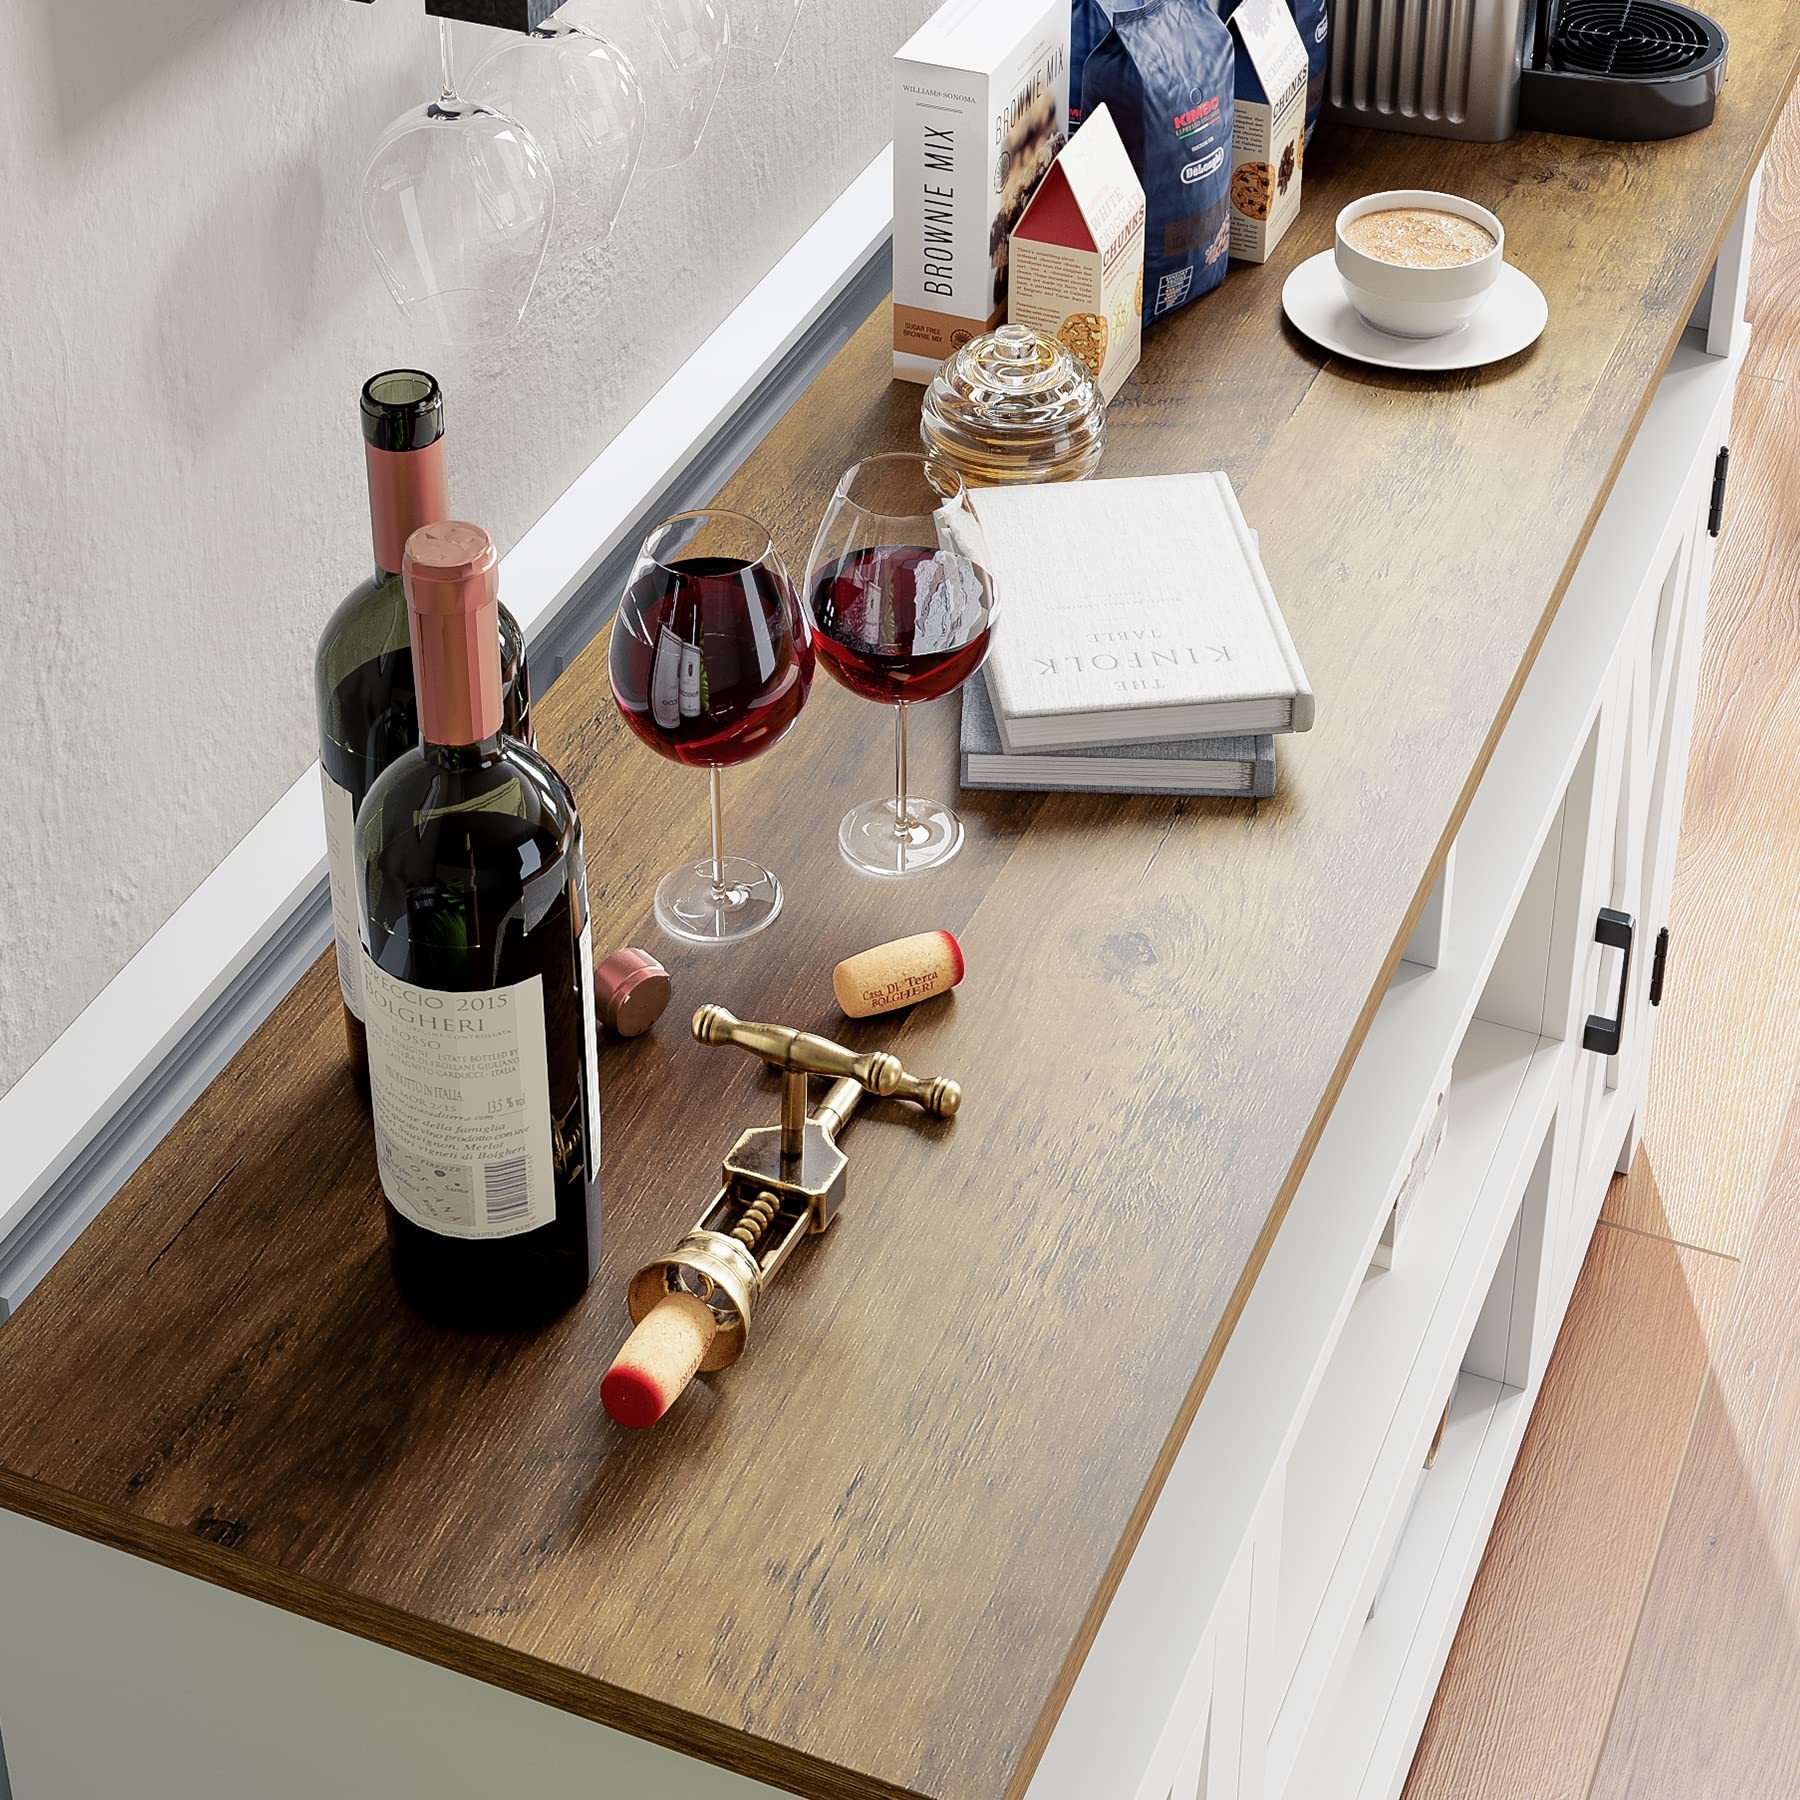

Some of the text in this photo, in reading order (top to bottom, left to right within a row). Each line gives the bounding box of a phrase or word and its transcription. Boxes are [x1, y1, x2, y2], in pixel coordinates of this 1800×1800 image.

[996, 68, 1042, 145] BROWNIE
[1046, 43, 1064, 87] MIX
[1273, 64, 1308, 118] CHUNKS
[1173, 96, 1220, 129] KIMBO
[924, 125, 954, 297] BROWNIE MIX
[1103, 204, 1144, 268] CHUNKS
[903, 329, 943, 343] BROWNIE MIX
[904, 321, 941, 334] SUGAR FREE
[1086, 629, 1162, 643] TABLE
[1033, 645, 1232, 675] KINFOLK
[1114, 678, 1167, 691] THE
[862, 989, 883, 1001] Casa
[904, 971, 939, 987] Terra
[871, 980, 935, 1008] BOLGHERI
[365, 973, 484, 1033] BOLGHERI
[456, 993, 508, 1012] 2015
[470, 1051, 508, 1062] BOTTLED
[422, 1120, 452, 1132] della
[463, 1141, 505, 1152] Merlot
[477, 1144, 526, 1160] Bolgheri
